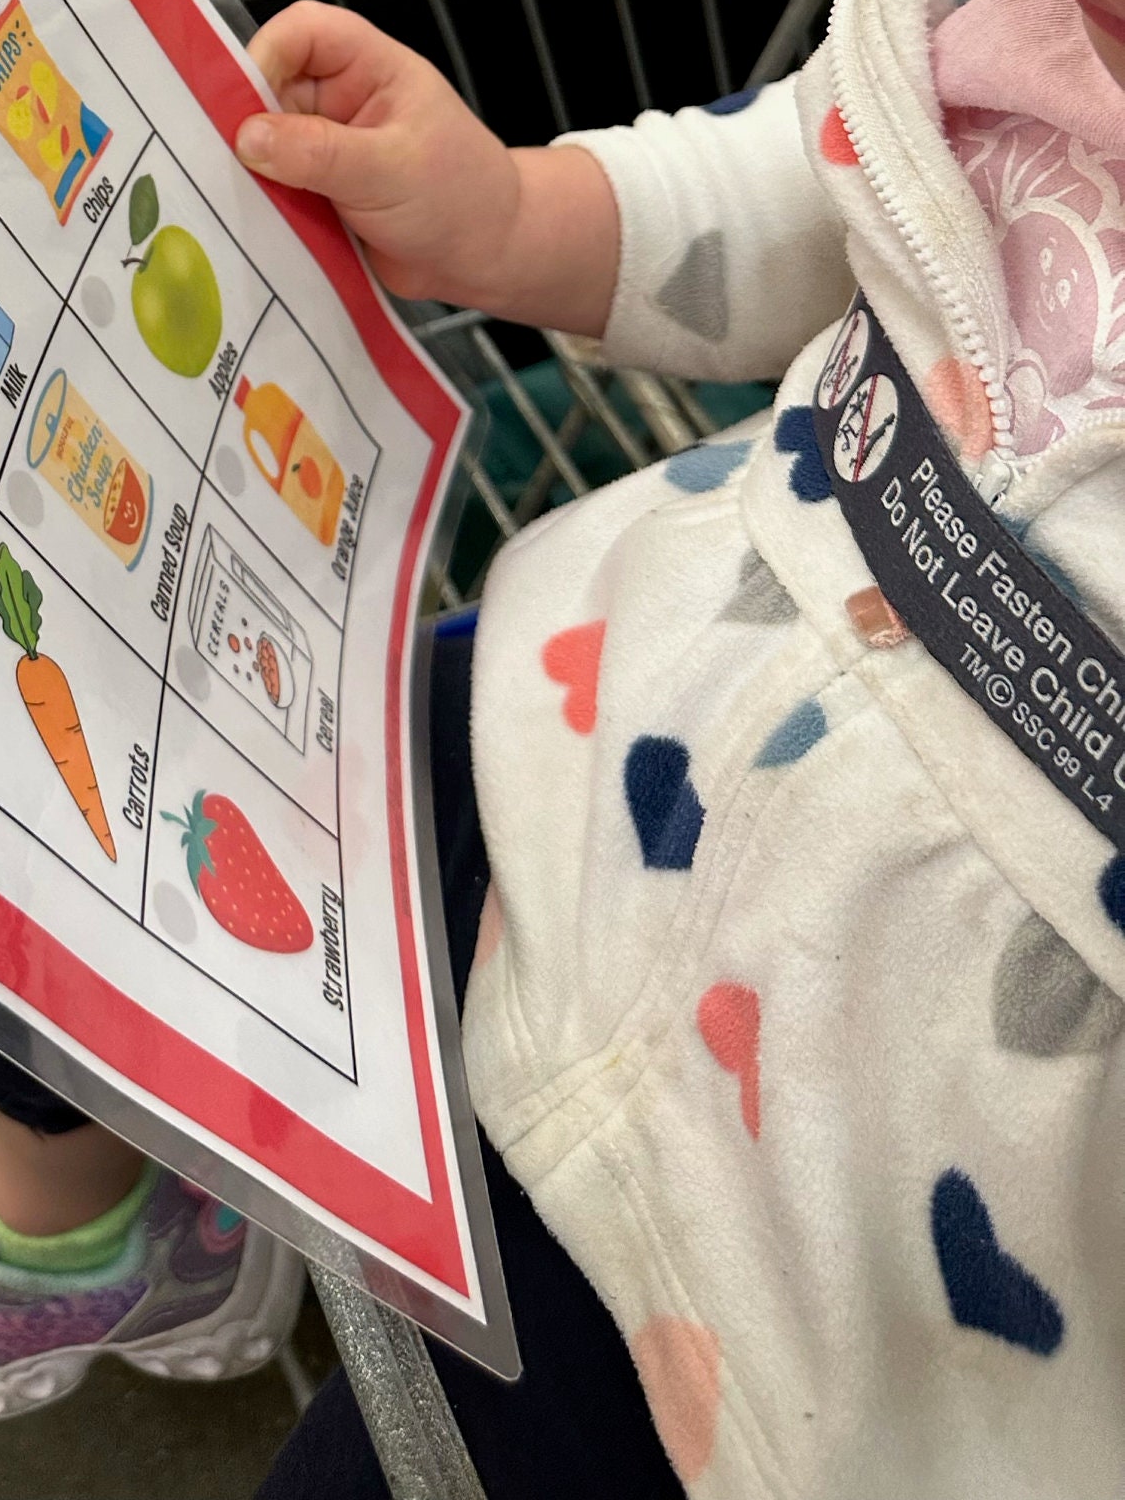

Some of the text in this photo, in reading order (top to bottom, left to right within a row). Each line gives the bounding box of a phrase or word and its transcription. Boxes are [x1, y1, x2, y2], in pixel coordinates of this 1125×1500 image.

[82, 175, 115, 224] Chips
[0, 362, 28, 409] Milk
[208, 341, 238, 401] Apples
[67, 423, 104, 503] Chicken
[86, 454, 113, 508] Soup
[150, 502, 192, 623] Canned Soup
[331, 473, 365, 582] Orange Juice
[208, 579, 231, 658] CEREALS
[880, 476, 1114, 762] Do Not Leave Child
[910, 457, 1125, 733] Please Fasten Chi
[315, 688, 336, 754] Cereal
[1011, 700, 1057, 752] SSC
[1052, 746, 1081, 778] 99
[1080, 773, 1115, 813] L4
[122, 743, 151, 831] Carrots
[321, 883, 343, 1011] Strawberry
